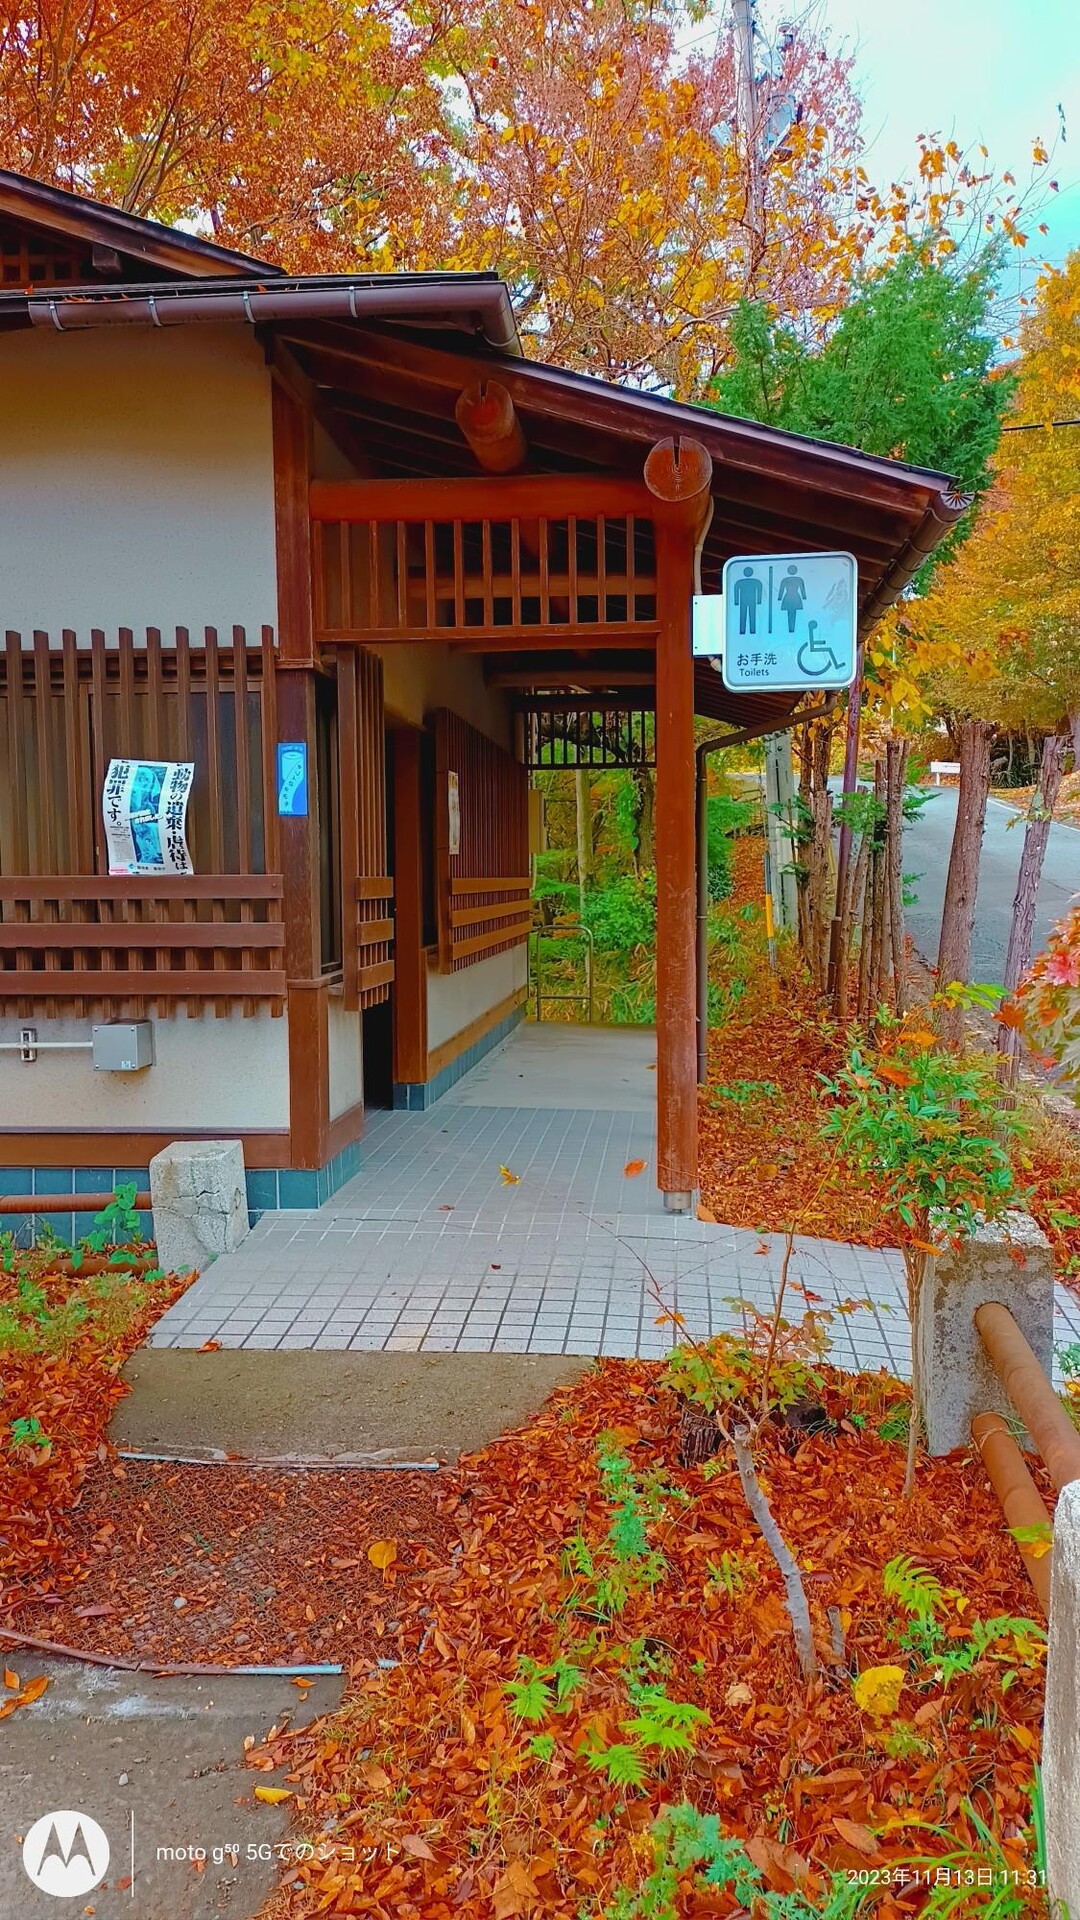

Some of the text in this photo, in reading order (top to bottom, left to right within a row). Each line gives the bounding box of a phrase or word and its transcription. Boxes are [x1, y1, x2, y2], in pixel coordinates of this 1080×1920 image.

[737, 652, 777, 666] お手洗
[739, 668, 770, 677] Toilets
